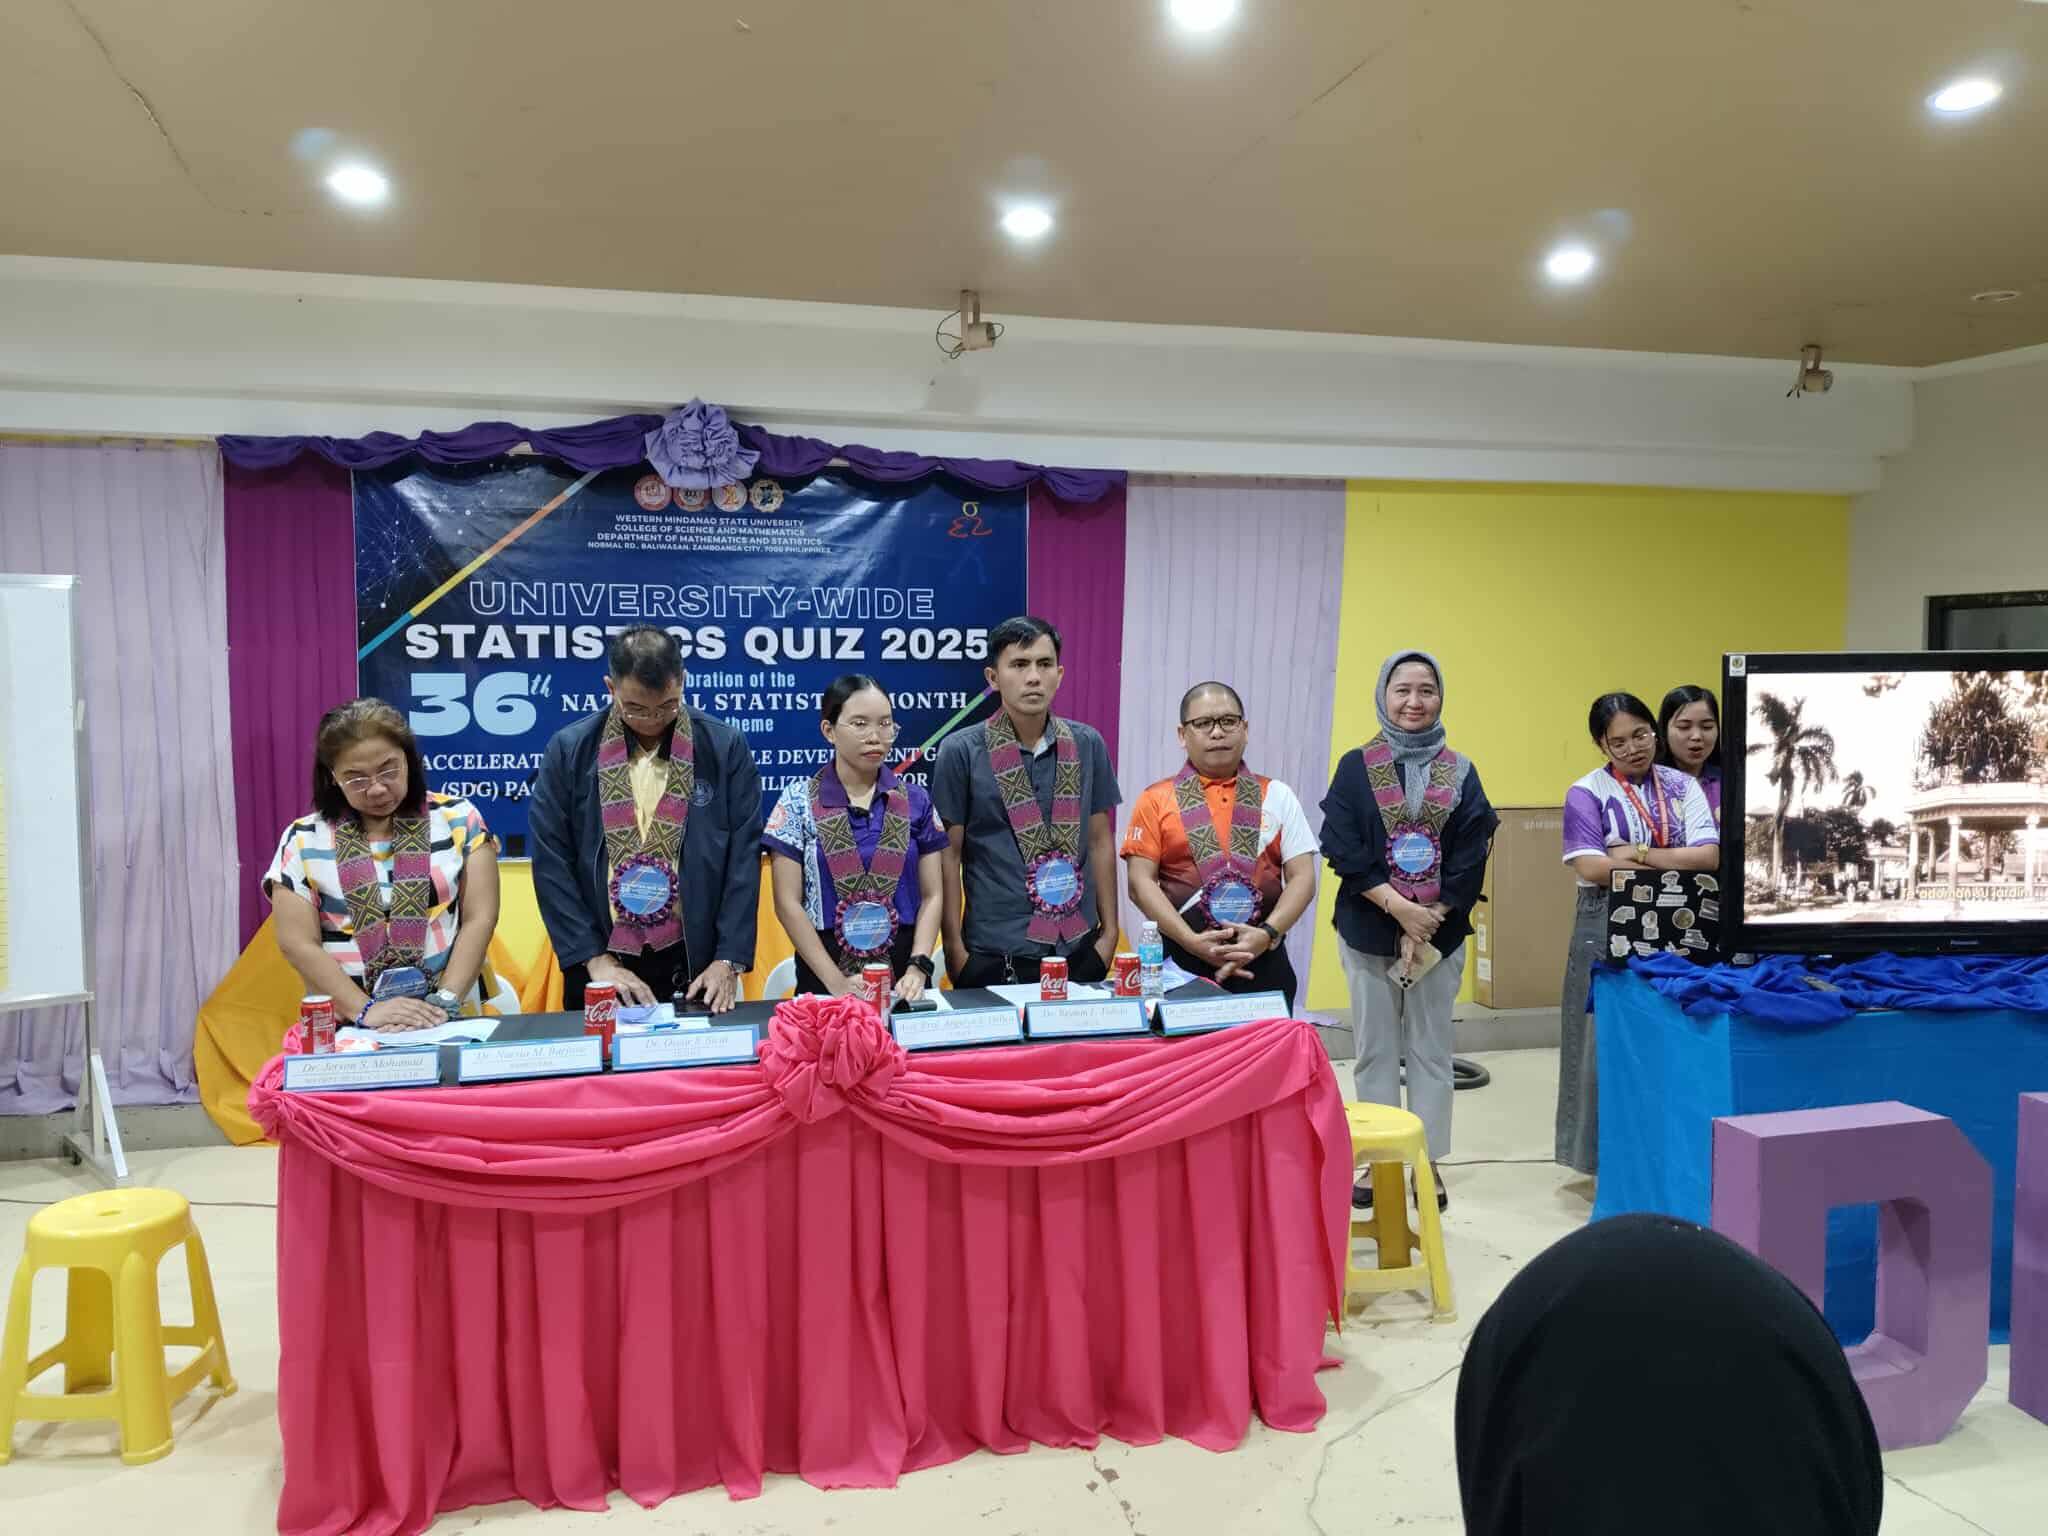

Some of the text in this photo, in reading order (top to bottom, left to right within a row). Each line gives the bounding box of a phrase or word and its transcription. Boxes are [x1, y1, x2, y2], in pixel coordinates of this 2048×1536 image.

[615, 514, 804, 528] WESTERN MINDANAO STATE UNIVERSITY
[597, 532, 823, 546] DEPARTMENT OF MATHEMATICS AND STATISTICS
[614, 524, 657, 532] COLLEGE
[675, 526, 714, 534] SCIENCE
[717, 527, 737, 535] AND
[739, 528, 804, 537] MATHEMATICS
[692, 544, 742, 552] ZAMBOANGA
[469, 581, 935, 620] UNIVERSITY-WIDE
[405, 624, 988, 665] STATISCS QUIZ 2025
[685, 671, 796, 688] bration of the
[714, 692, 824, 711] STATIST
[422, 753, 544, 771] ACCELERAT
